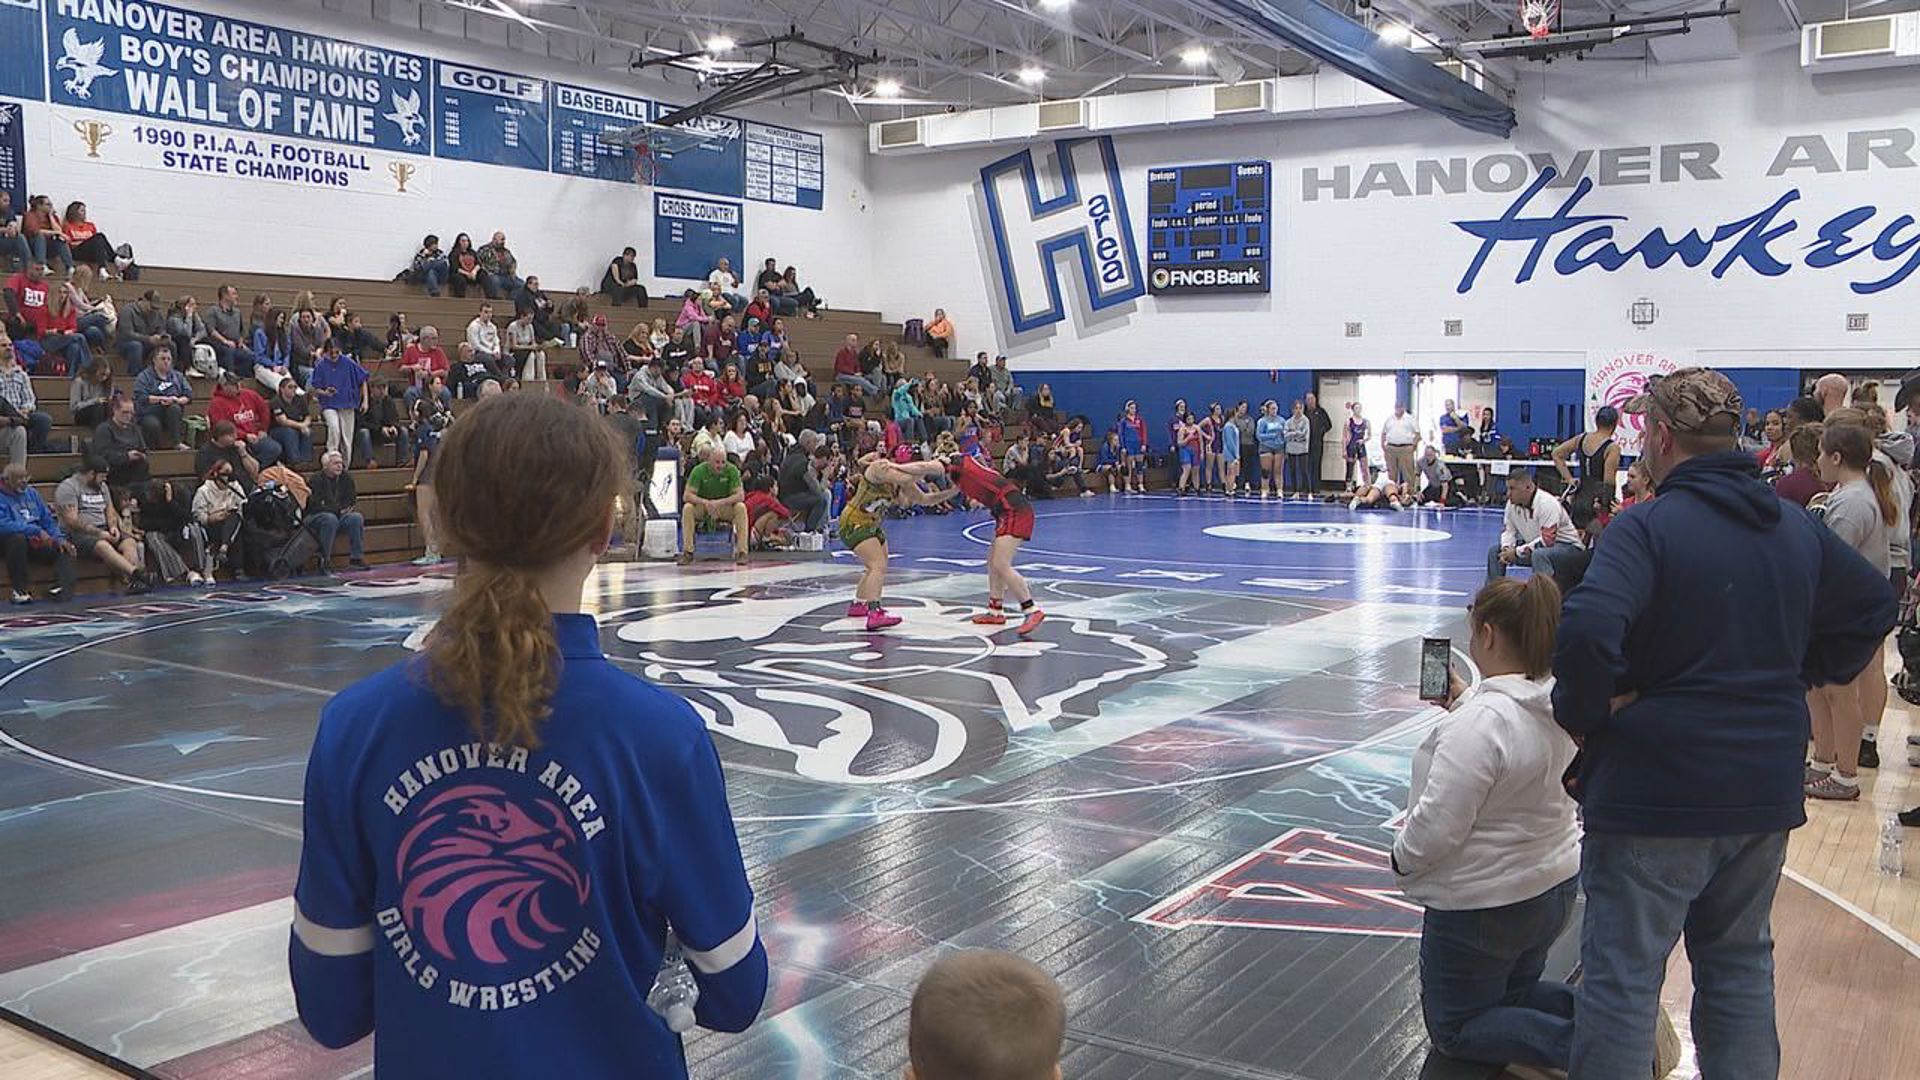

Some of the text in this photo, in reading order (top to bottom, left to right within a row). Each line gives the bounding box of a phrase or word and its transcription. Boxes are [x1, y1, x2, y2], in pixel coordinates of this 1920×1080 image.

[57, 0, 422, 82] HANOVER AREA HAWKEYES
[120, 34, 381, 103] BOY'S CHAMPIONS
[453, 71, 533, 96] GOLF
[124, 68, 376, 144] WALL OF FAME
[562, 90, 643, 118] BASEBALL
[133, 126, 371, 171] 1990 P.I.A.A. FOOTBALL
[163, 150, 349, 187] STATE CHAMPIONS
[1302, 141, 1723, 202] HANOVER
[662, 199, 735, 221] CROSS COUNTRY
[1088, 194, 1125, 283] area
[1170, 266, 1260, 286] FNCB Bank
[1591, 353, 1655, 388] HANOVER
[384, 742, 607, 840] HANOVER AREA
[377, 906, 602, 1012] GIRLS WRESTLING
